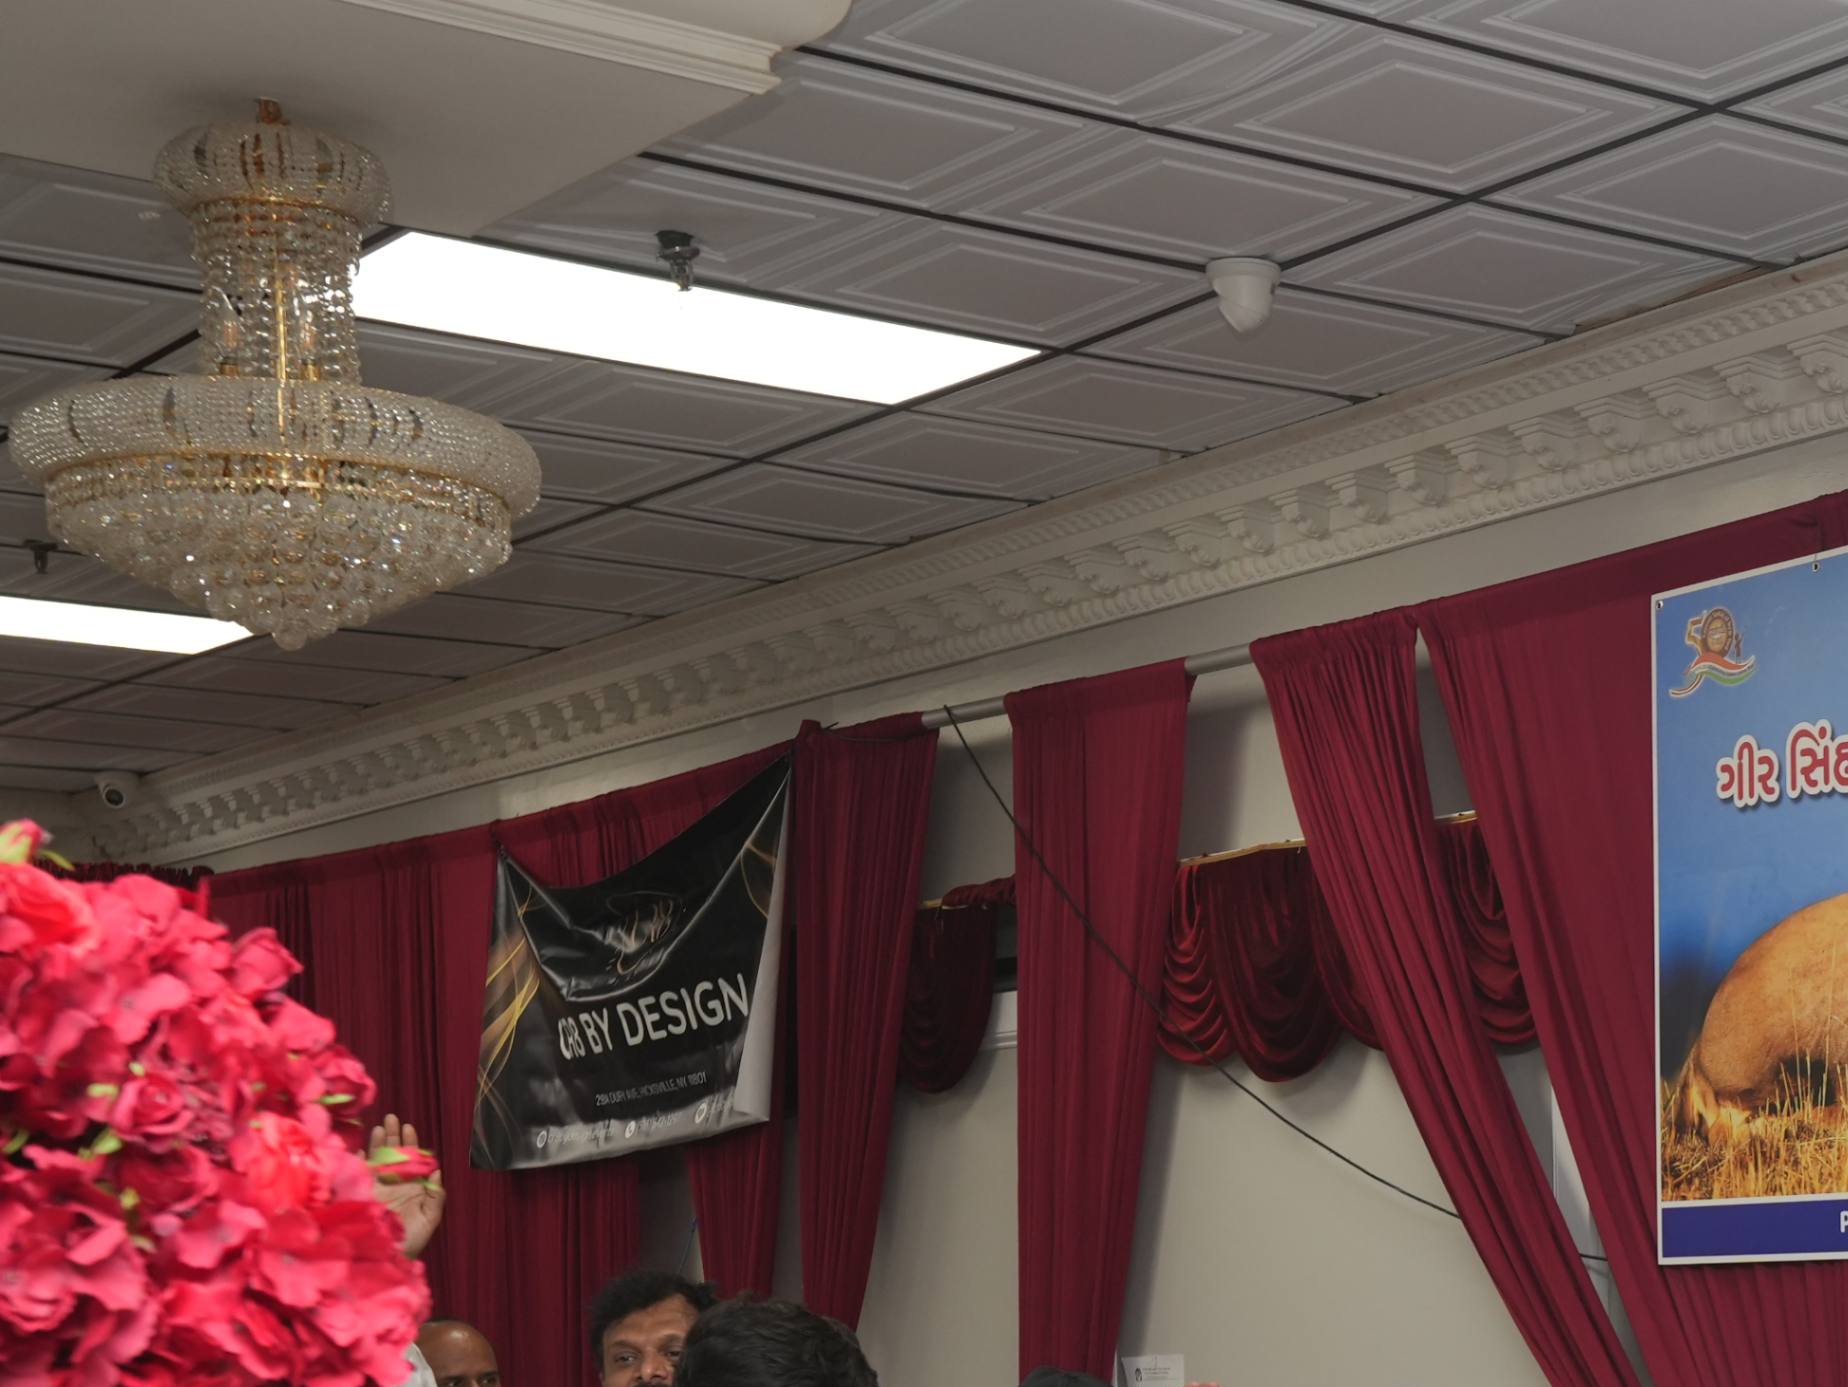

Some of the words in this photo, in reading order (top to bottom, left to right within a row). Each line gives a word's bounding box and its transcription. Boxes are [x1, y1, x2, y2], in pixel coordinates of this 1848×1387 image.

[1718, 738, 1778, 804] ગીર
[578, 1008, 613, 1054] BY
[616, 973, 750, 1047] DESIGN
